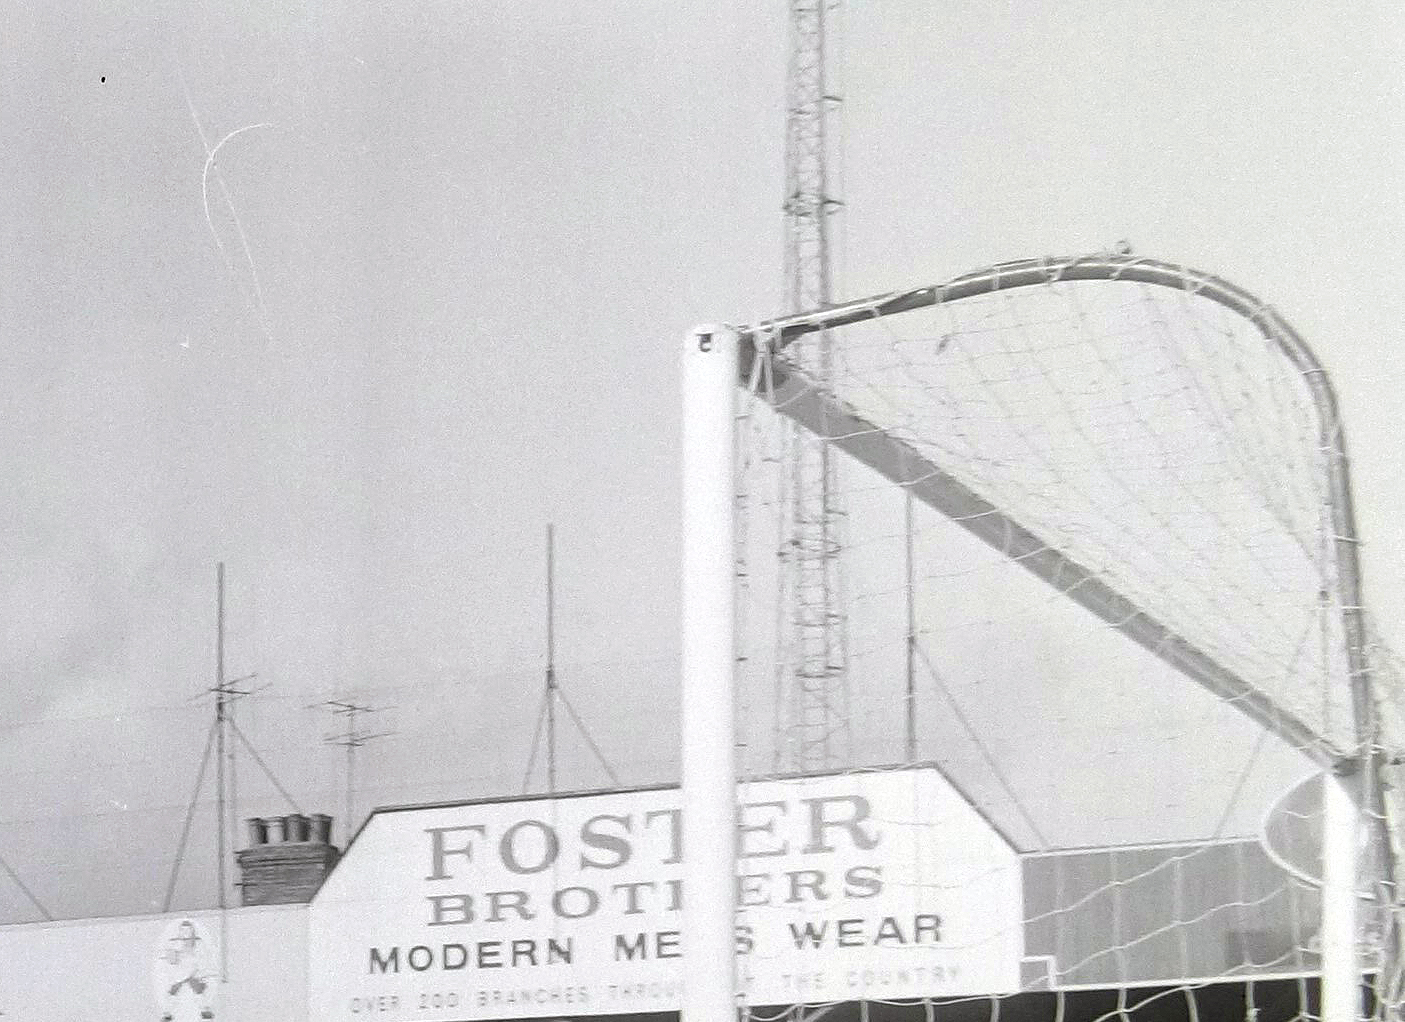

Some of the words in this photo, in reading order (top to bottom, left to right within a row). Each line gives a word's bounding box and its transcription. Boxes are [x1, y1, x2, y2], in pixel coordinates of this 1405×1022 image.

[424, 794, 883, 882] FOSTER
[369, 937, 573, 975] MODERN
[614, 926, 754, 962] MES
[789, 913, 944, 950] WEAR
